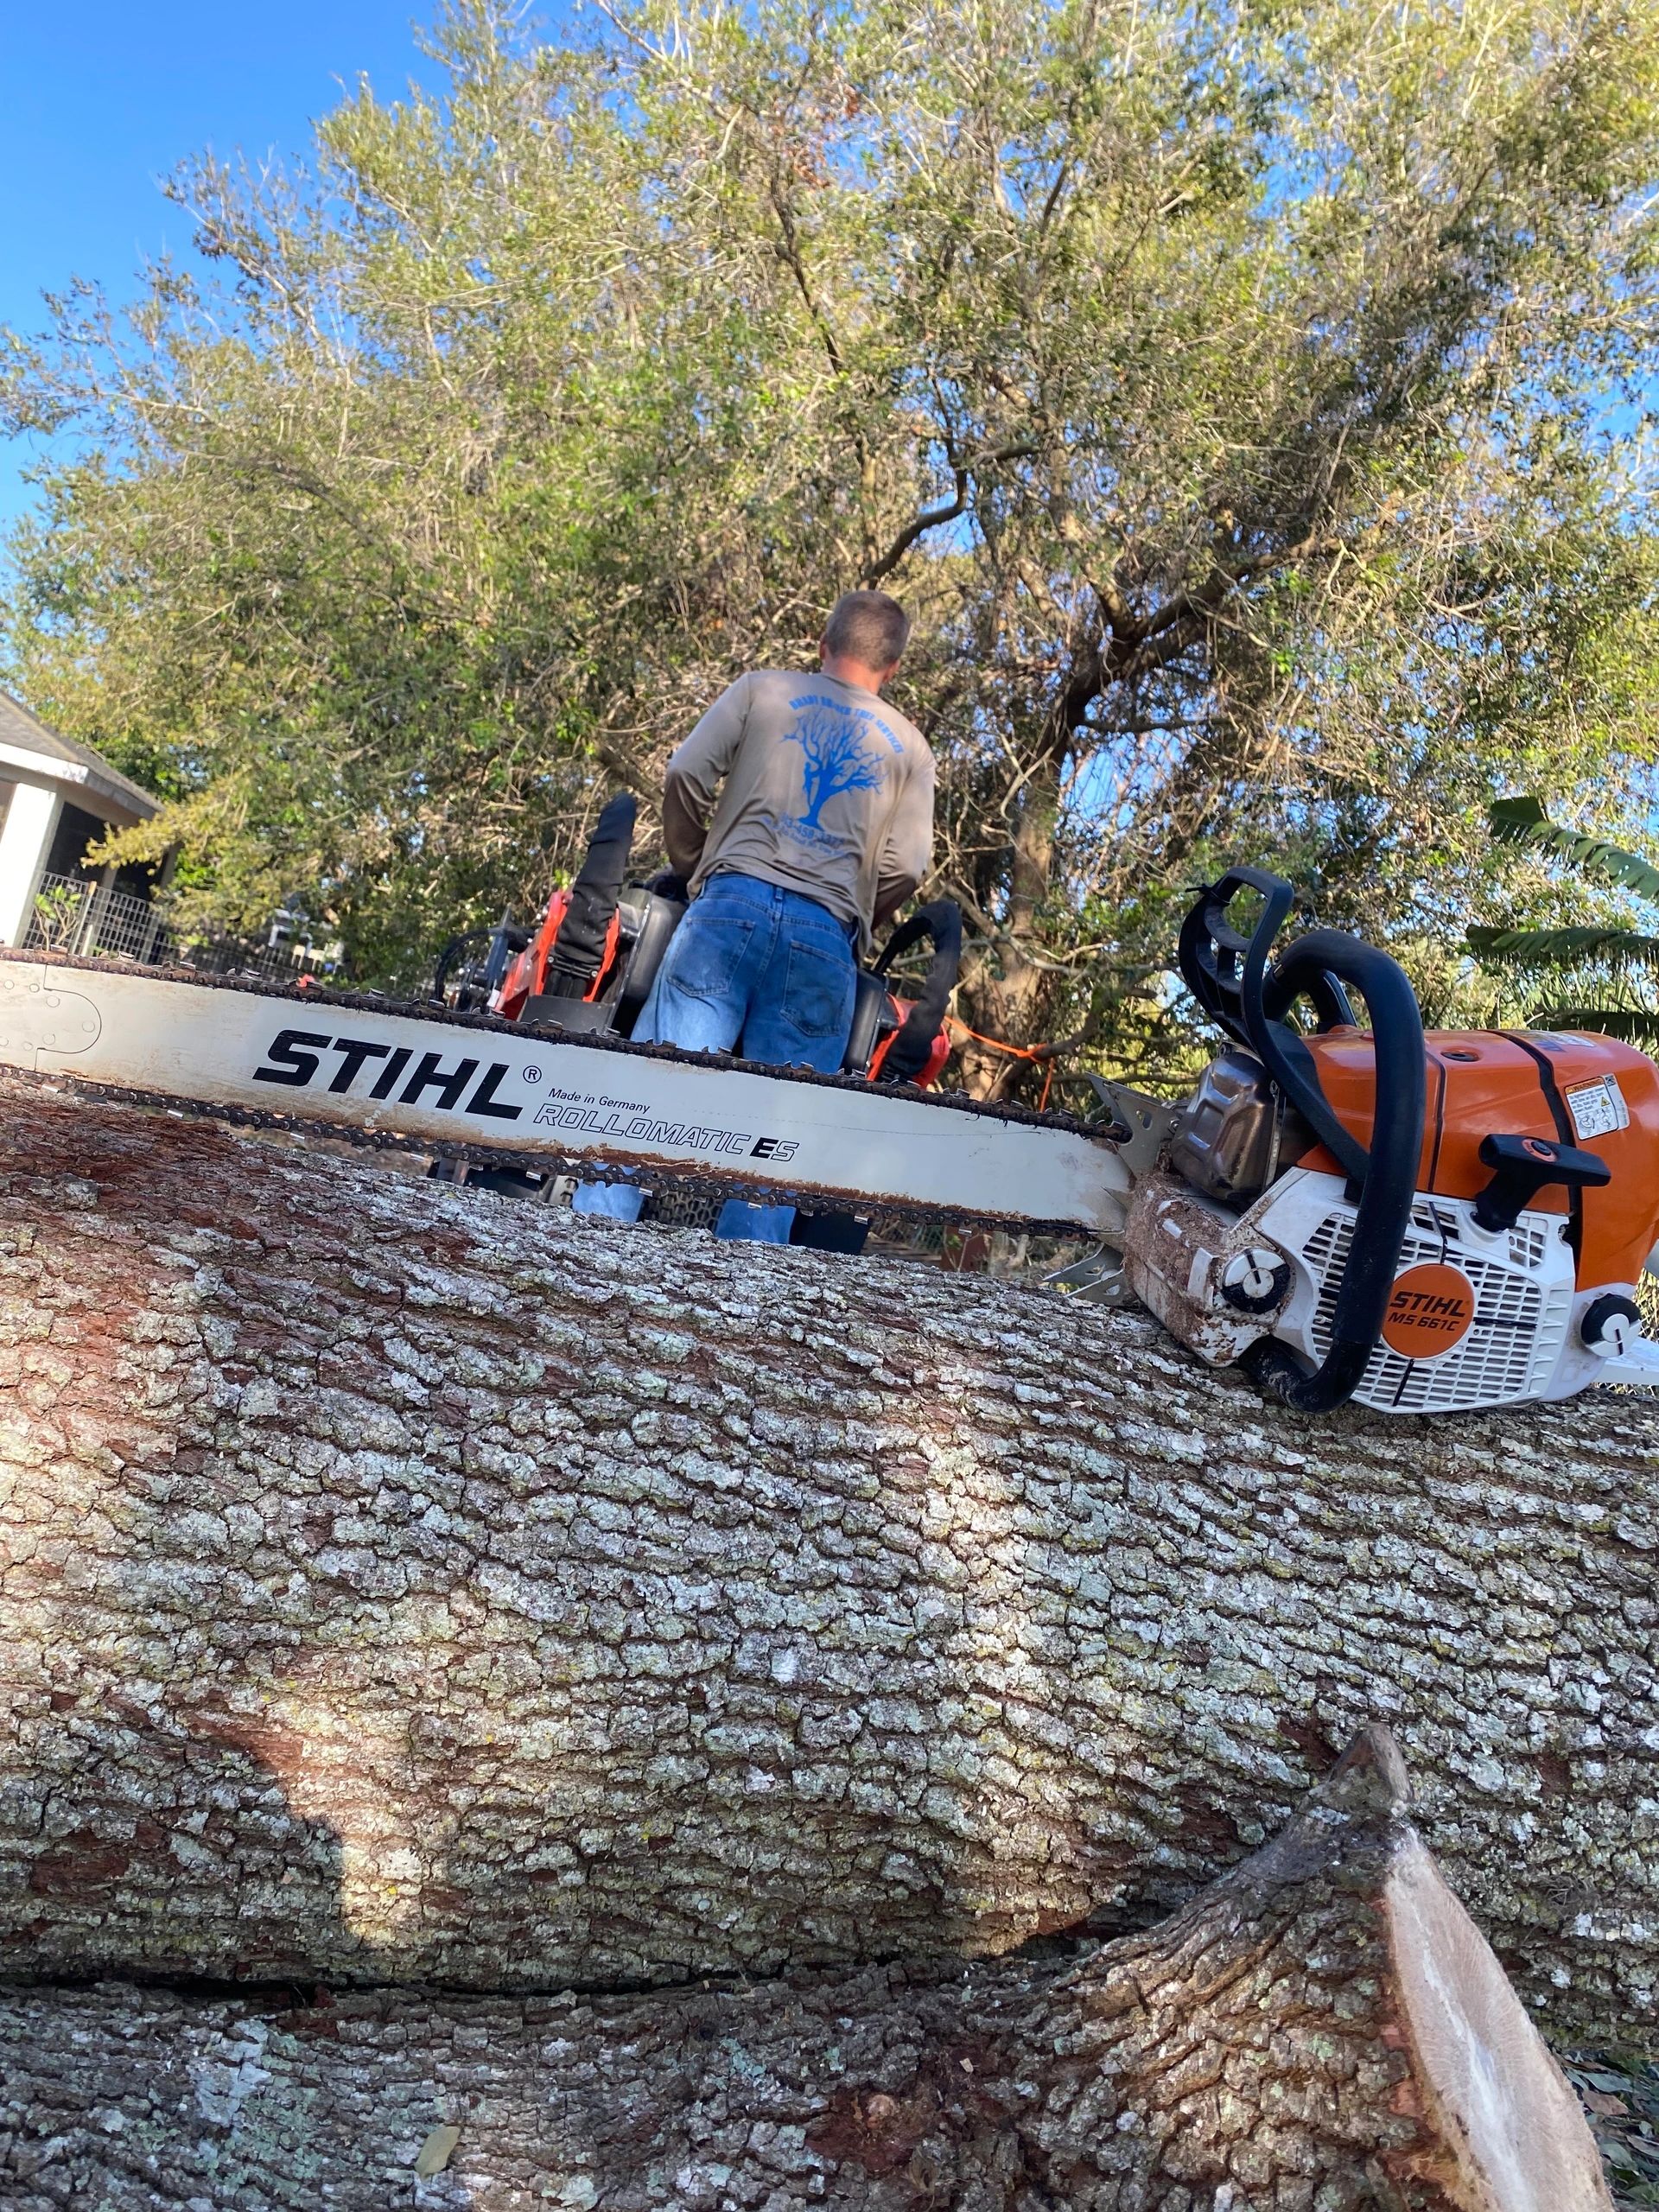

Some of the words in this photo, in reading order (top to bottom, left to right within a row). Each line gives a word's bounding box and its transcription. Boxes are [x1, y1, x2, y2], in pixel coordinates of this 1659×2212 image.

[252, 1029, 523, 1121] STIHL
[548, 1088, 582, 1101] Made
[585, 1092, 595, 1103] in
[599, 1095, 651, 1114] Germany
[533, 1103, 751, 1155] ROLLOMATIC
[750, 1136, 800, 1162] ES
[1389, 1291, 1466, 1318] STIHL
[1388, 1312, 1418, 1325] MS
[1417, 1316, 1460, 1332] 661C
